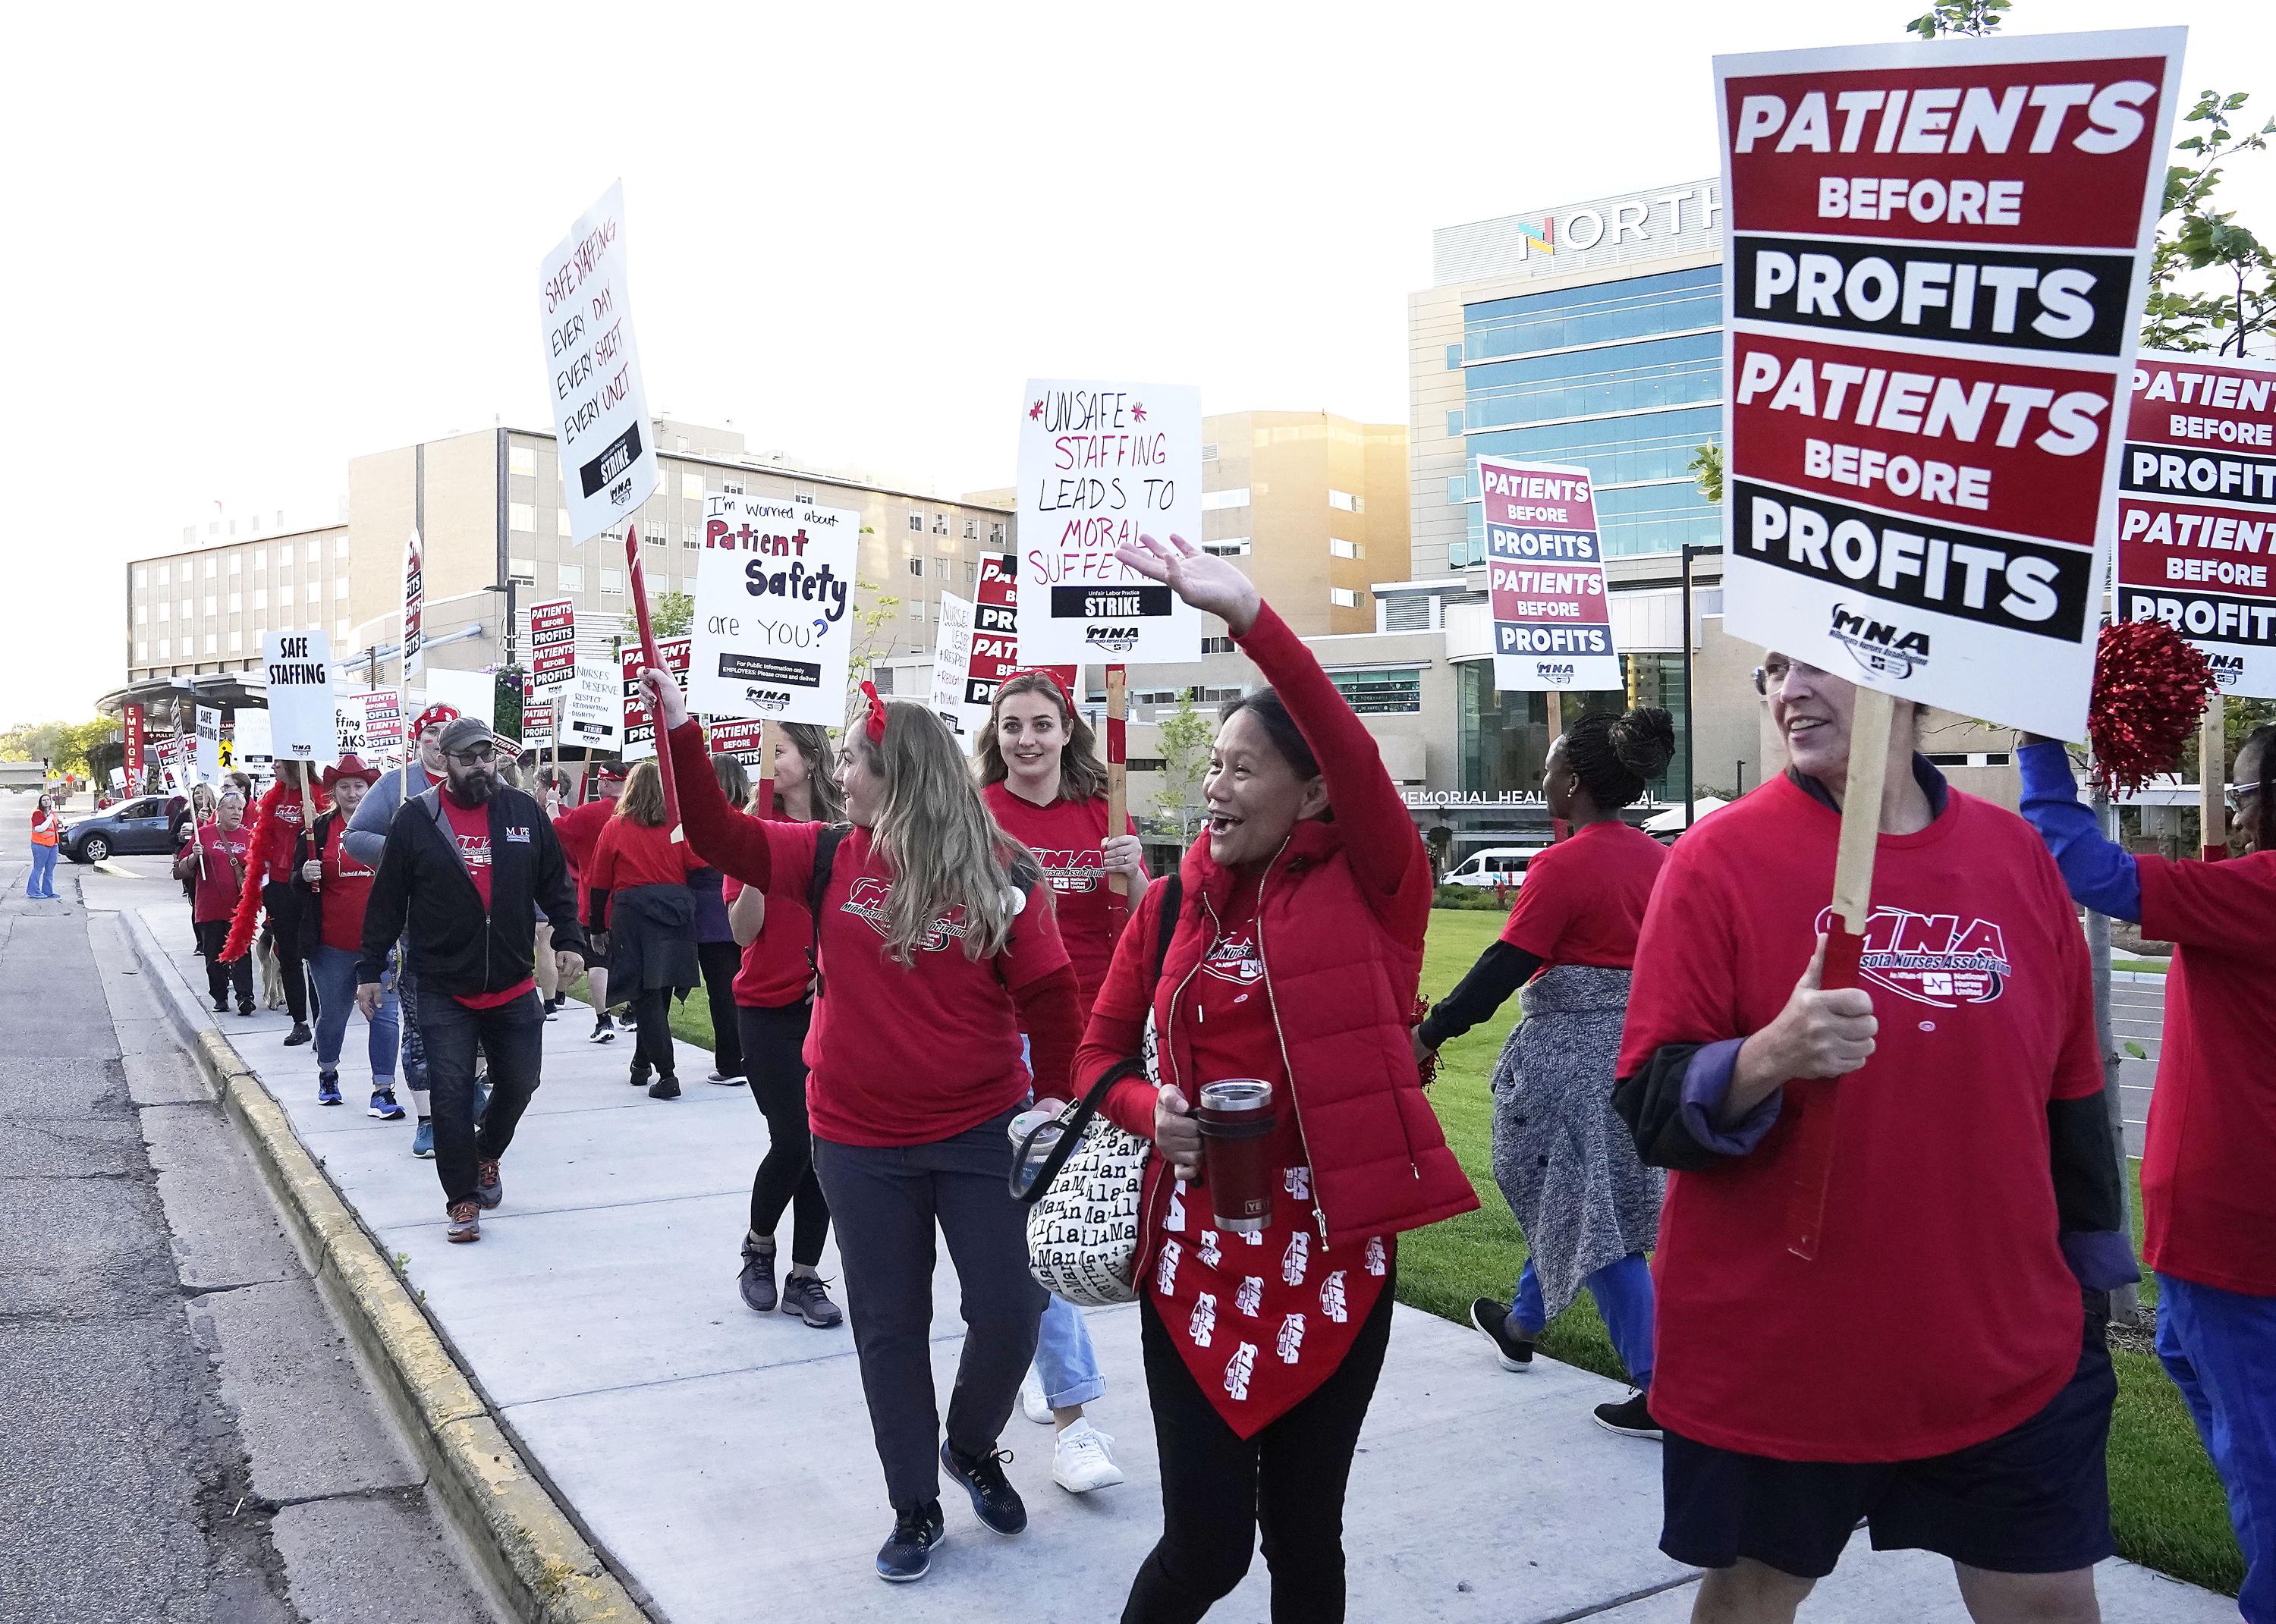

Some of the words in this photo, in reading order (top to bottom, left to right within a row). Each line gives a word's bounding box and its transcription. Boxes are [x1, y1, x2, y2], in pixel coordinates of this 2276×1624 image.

[1734, 80, 2158, 154] PATIENTS
[1818, 177, 2025, 226] BEFORE
[545, 258, 575, 314] SAFE
[572, 215, 617, 284] STAFFING
[1755, 250, 2098, 340] PROFITS
[552, 306, 584, 358] EVERY
[592, 278, 613, 321] DAY
[558, 350, 593, 401] EVERY
[595, 316, 623, 367] SHIFT
[2131, 369, 2276, 413] PATIEN
[564, 396, 600, 445] EVERY
[602, 360, 629, 412] UNIT
[1045, 389, 1127, 432] UNSAFE
[1736, 351, 2111, 457] PATIENTS
[2170, 414, 2273, 446] BEFORE
[1055, 432, 1165, 470] STAFFING
[600, 444, 630, 485] STRIKE
[1805, 438, 1992, 510] BEFORE
[2133, 451, 2276, 498] PROFIT
[1039, 477, 1127, 511] LEADS
[1144, 479, 1174, 510] TO
[1485, 470, 1589, 503] PATIENTS
[707, 497, 735, 517] I'm
[804, 510, 839, 526] about
[1507, 504, 1568, 523] BEFORE
[706, 520, 809, 557] Patient
[2121, 509, 2276, 555] PATIEN
[1493, 529, 1592, 558] PROFITS
[1751, 495, 2061, 623] PROFITS
[1492, 569, 1602, 595] PATIENTS
[2166, 558, 2267, 587] BEFORE
[745, 559, 847, 622] Safety
[532, 603, 572, 620] PATIENTS
[1085, 596, 1140, 617] STRIKE
[1517, 600, 1580, 617] BEFORE
[2132, 595, 2276, 640] PROFIT
[541, 617, 564, 628] BEFORE
[709, 614, 739, 636] are
[758, 618, 828, 648] YOU?
[1086, 628, 1139, 639] MNA
[1833, 610, 1929, 657] MNA
[281, 637, 308, 658] SAFE
[534, 628, 572, 645] PROFITS
[1501, 627, 1606, 652] PROFITS
[533, 643, 574, 661] PATIENTS
[542, 658, 566, 668] BEFORE
[624, 643, 691, 665] PAENT
[269, 663, 325, 685] STAFFING
[536, 668, 573, 686] PROFITS
[577, 666, 609, 680] NURSES
[722, 667, 756, 675] EMPLOYEES:
[1538, 664, 1575, 674] MNA
[366, 693, 397, 703] TIENTS
[582, 680, 619, 696] DESERVE
[747, 689, 791, 702] MNA
[200, 710, 212, 724] SAFE
[336, 717, 360, 730] ffing
[368, 709, 398, 720] OFITS
[524, 708, 552, 718] PATIENT
[196, 726, 217, 741] STAFFING
[366, 720, 401, 730] TIENTS
[583, 725, 603, 733] STRIKE
[711, 723, 760, 740] PATIENTS
[493, 737, 522, 755] ATIENTS
[723, 739, 750, 749] BEFORE
[734, 751, 759, 765] FITS
[1064, 869, 1105, 878] Association
[1895, 953, 1940, 969] Nurses
